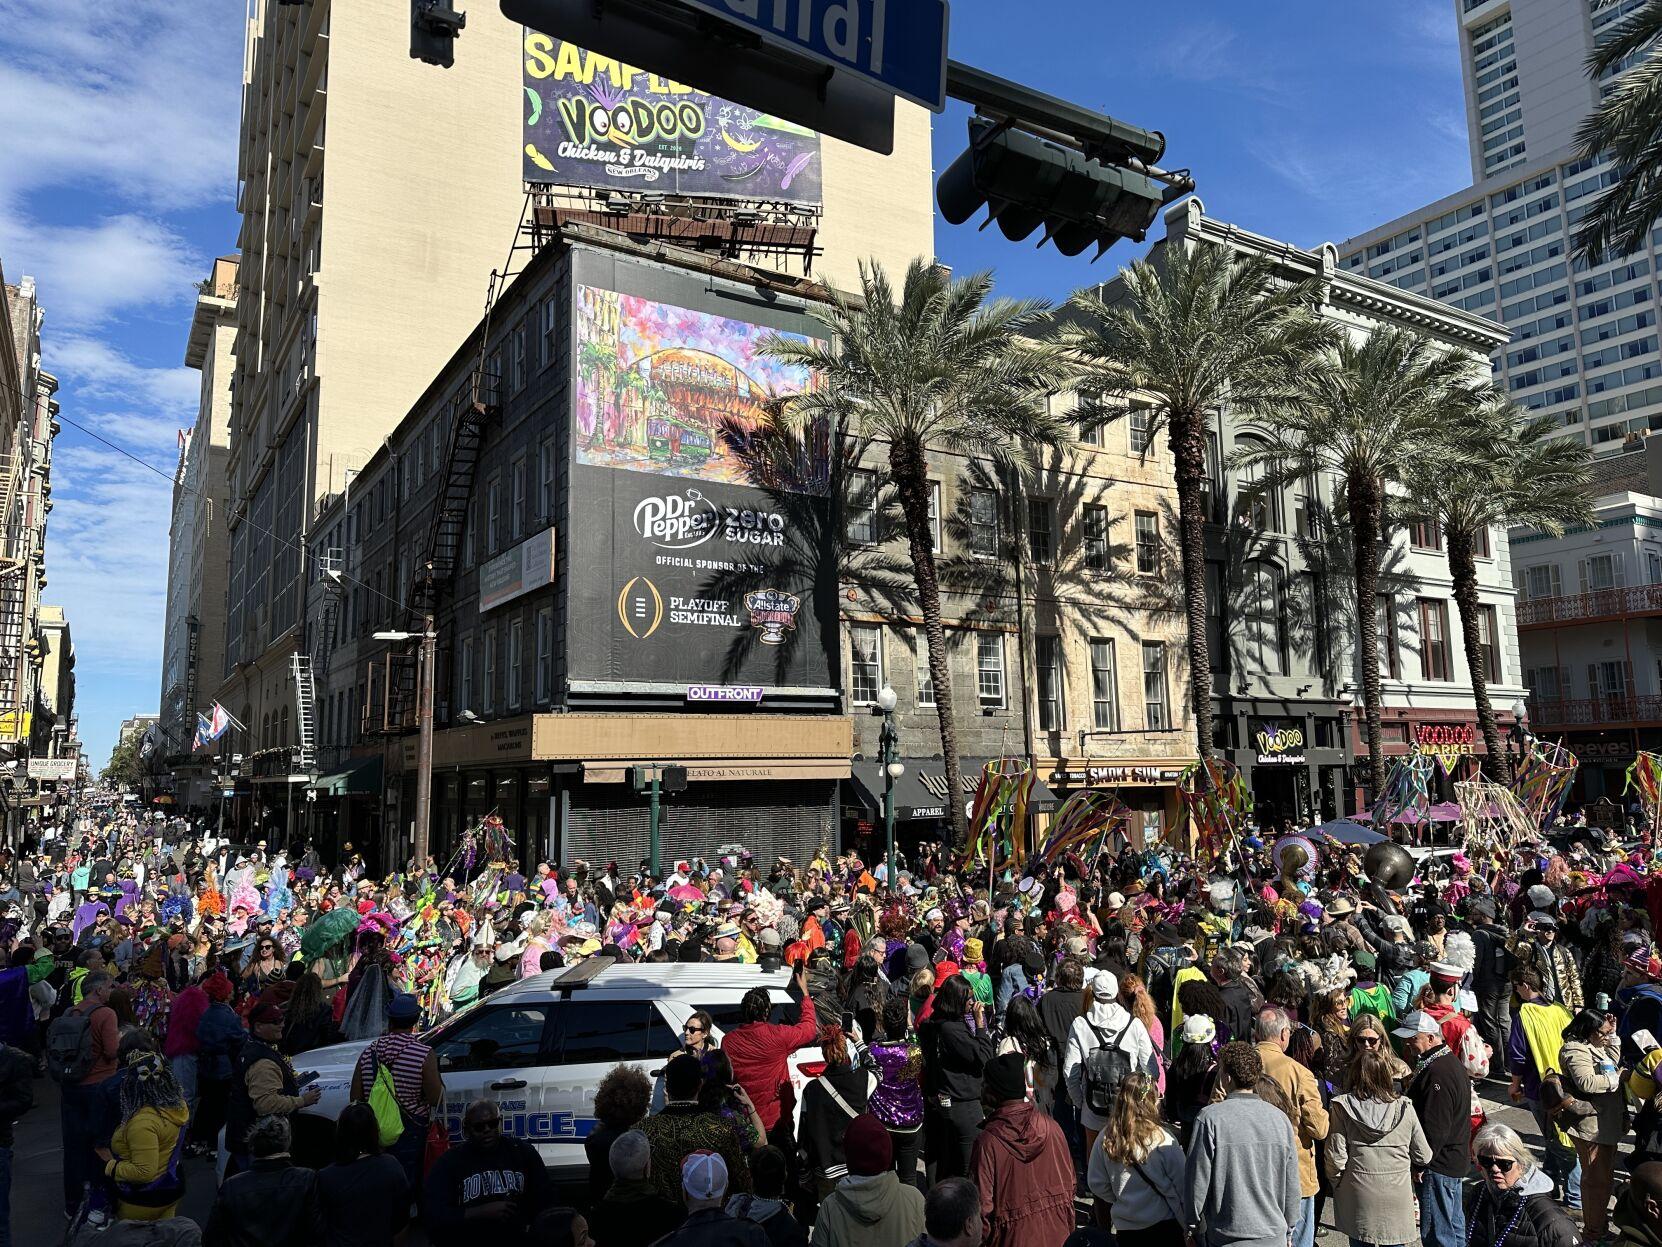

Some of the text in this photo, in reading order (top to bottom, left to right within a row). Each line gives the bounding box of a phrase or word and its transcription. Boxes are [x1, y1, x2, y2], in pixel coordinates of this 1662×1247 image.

[556, 96, 705, 147] VOODOO
[558, 141, 706, 173] Chicken & Daiquiris
[643, 495, 713, 542] Dr Pepper
[725, 508, 785, 532] zero
[725, 527, 785, 546] SUGAR
[655, 555, 764, 574] OFFICIAL SPONSOR OF THE
[670, 597, 729, 612] PLAYOFF
[753, 600, 790, 611] Allstate
[670, 611, 742, 627] SEMIFINAL
[690, 687, 760, 700] OUTFRONT
[1256, 729, 1303, 755] VOODOO
[1414, 725, 1473, 744] VOODOO
[1420, 744, 1474, 755] MARKET
[728, 769, 773, 777] NATURALE
[1090, 768, 1132, 781] SMOKE
[912, 808, 945, 817] APPAREL
